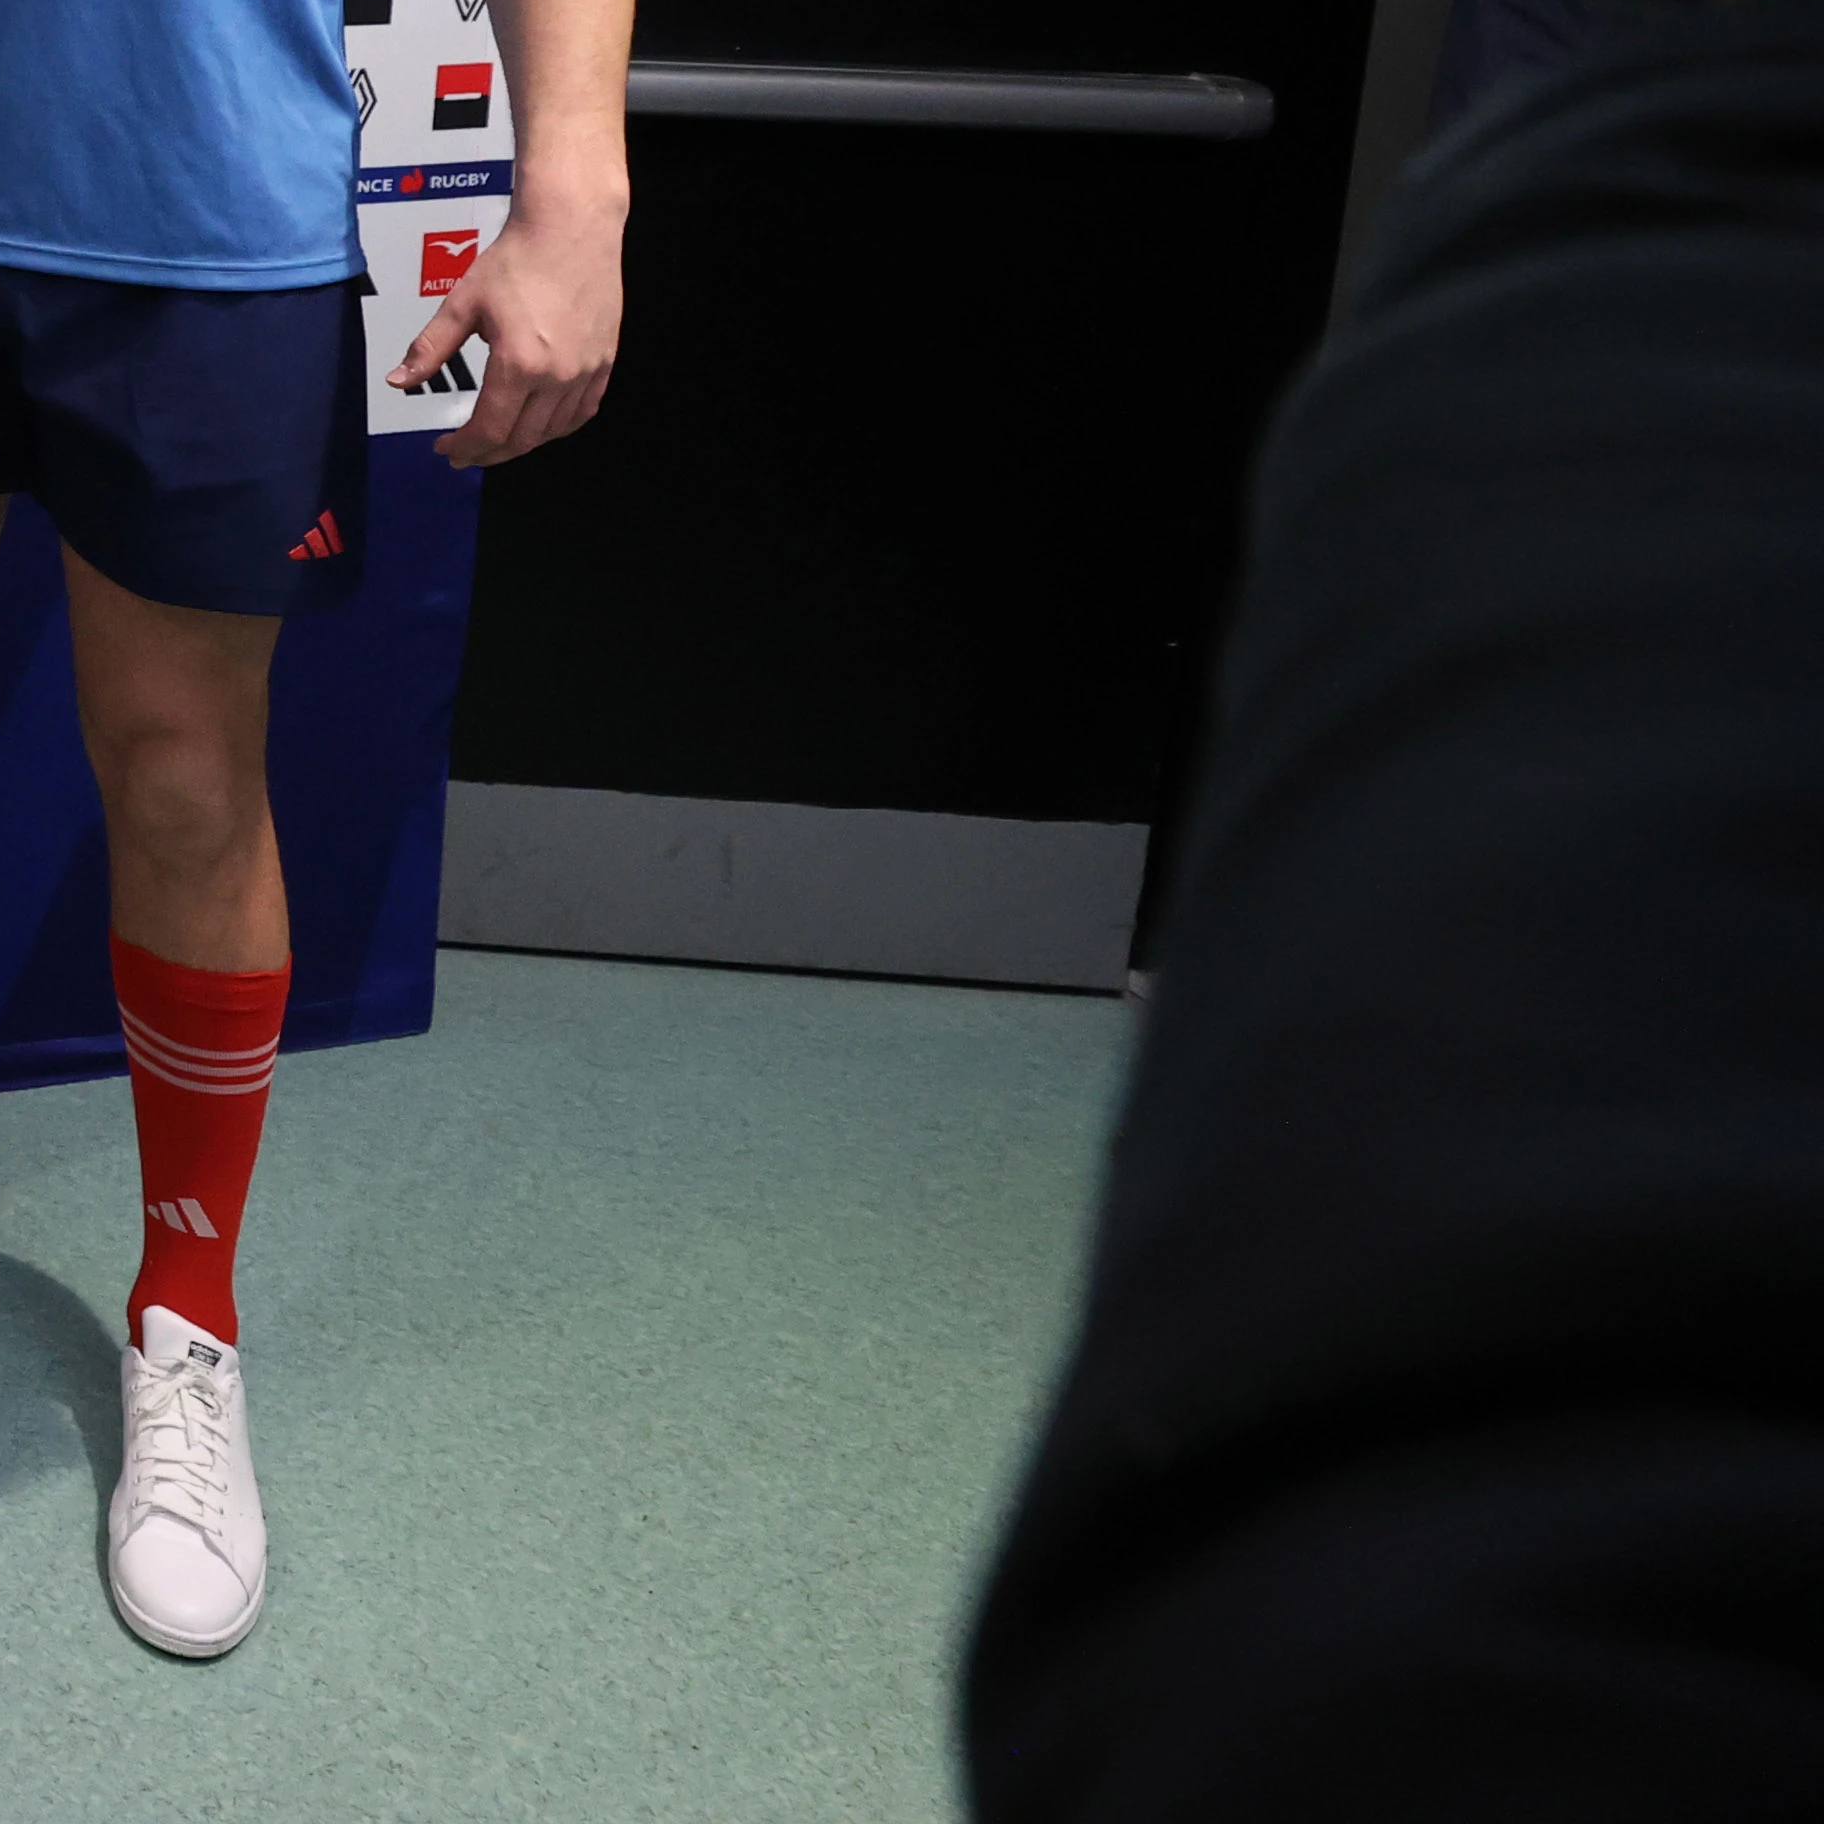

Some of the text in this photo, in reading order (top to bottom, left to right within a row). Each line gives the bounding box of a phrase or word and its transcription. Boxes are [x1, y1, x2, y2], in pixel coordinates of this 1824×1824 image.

[356, 172, 490, 193] NCE RUGBY
[422, 277, 462, 292] ALTR
